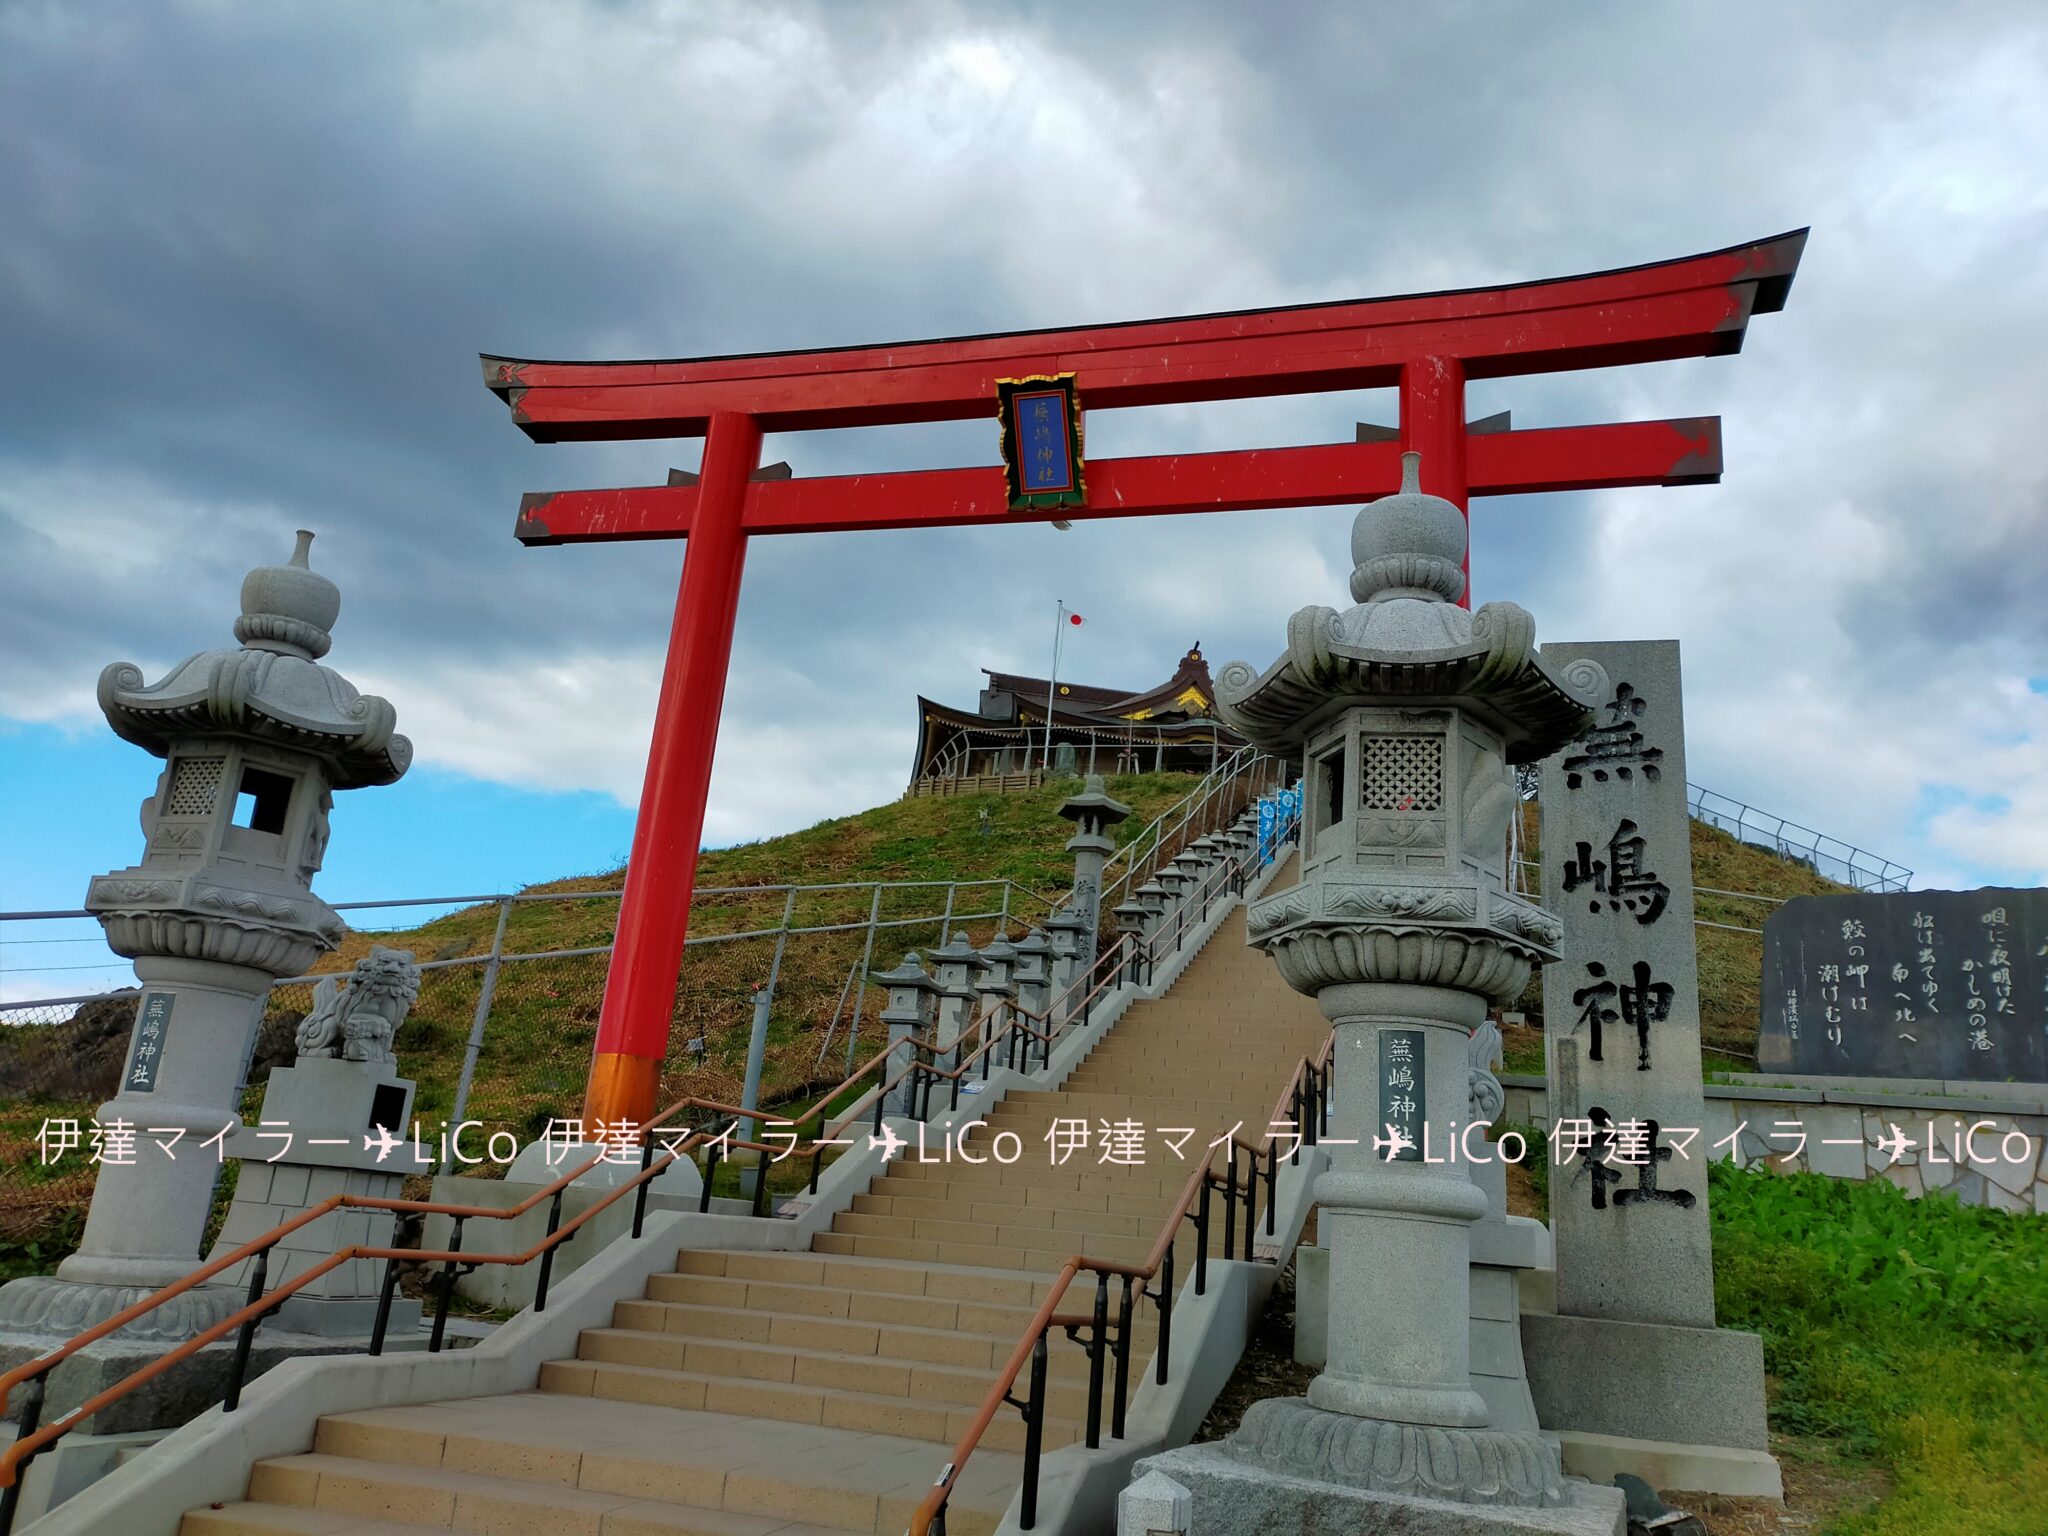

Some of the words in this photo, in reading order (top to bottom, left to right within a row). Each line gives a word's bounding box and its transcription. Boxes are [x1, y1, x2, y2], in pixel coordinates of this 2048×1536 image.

[1841, 918, 1870, 1011] 鮫の岬は
[1891, 962, 1918, 1043] 南へ北へ
[131, 999, 165, 1085] 蕪嶋神社
